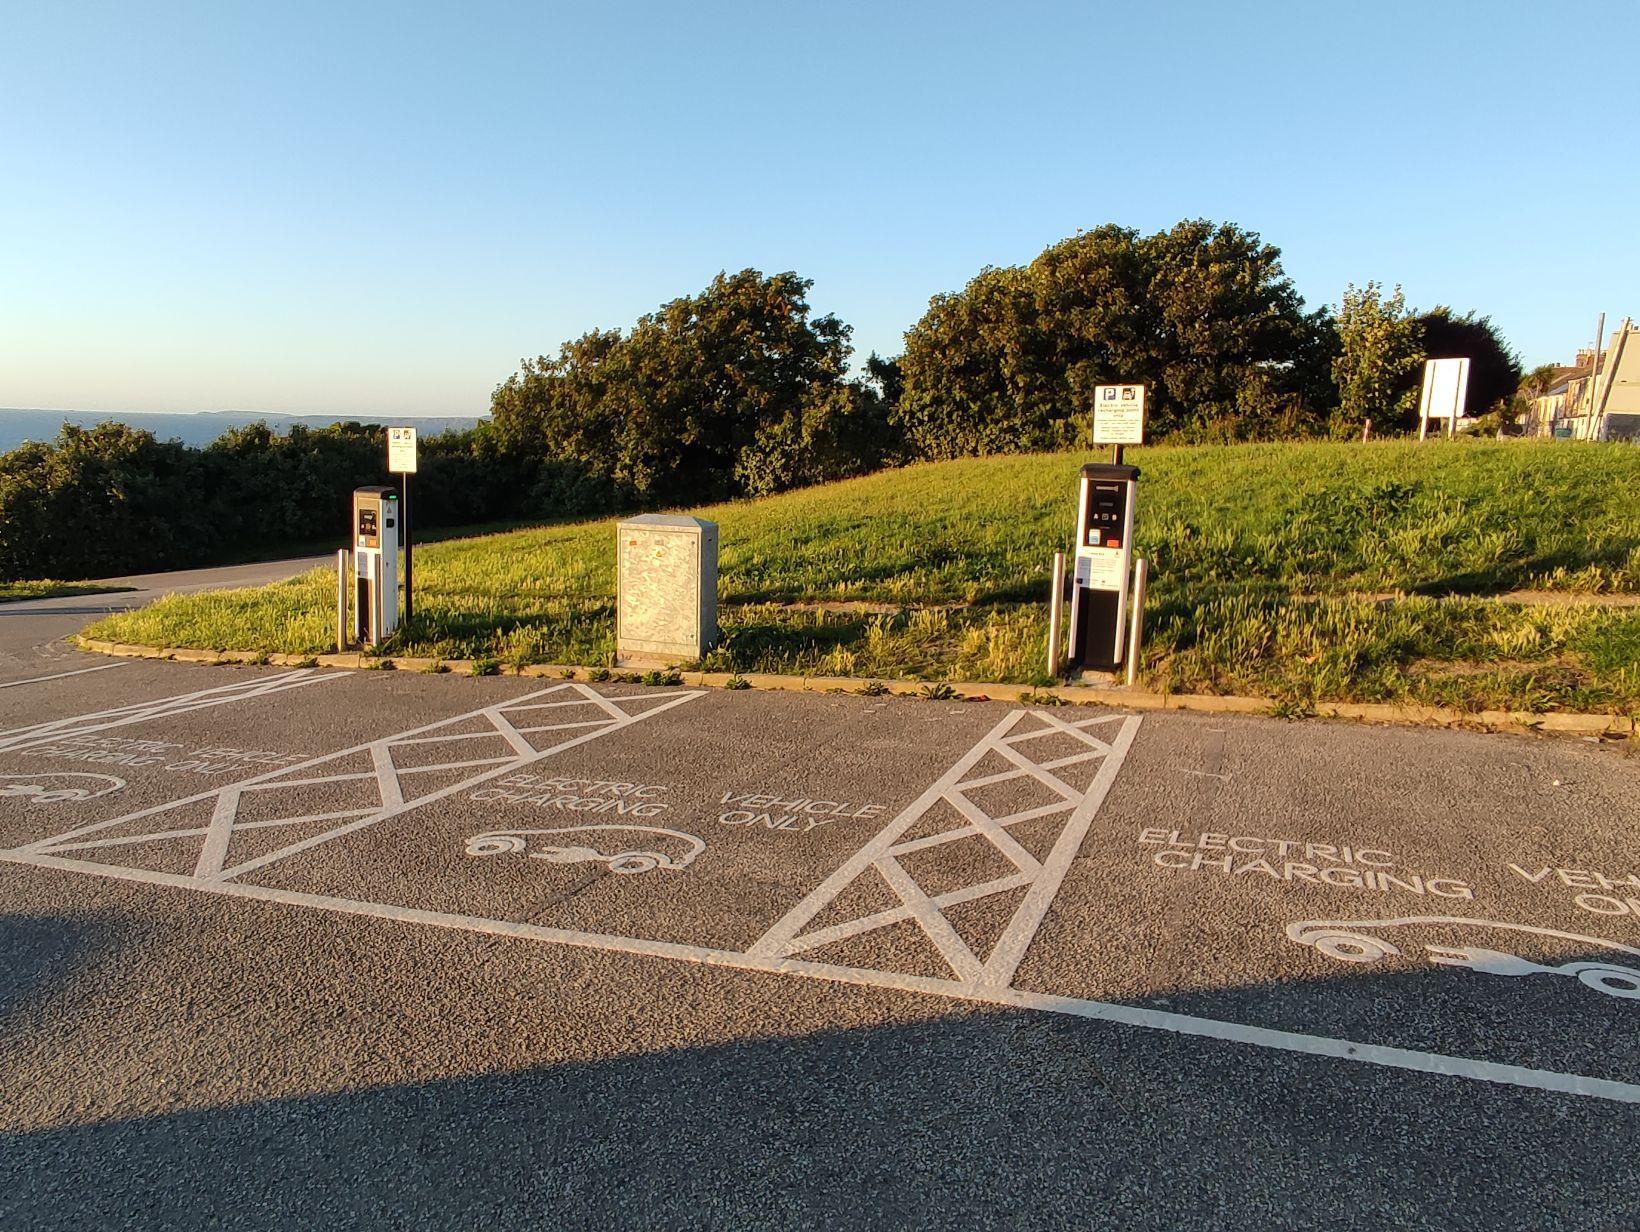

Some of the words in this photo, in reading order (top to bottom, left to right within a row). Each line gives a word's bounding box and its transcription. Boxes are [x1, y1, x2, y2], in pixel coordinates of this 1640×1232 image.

[469, 789, 668, 816] CHARGING
[719, 811, 834, 832] ONLY
[498, 774, 668, 797] ELECTRIC
[720, 792, 886, 818] VEHICLE
[1138, 827, 1395, 867] ELECTRIC
[1153, 850, 1475, 900] CHARGING
